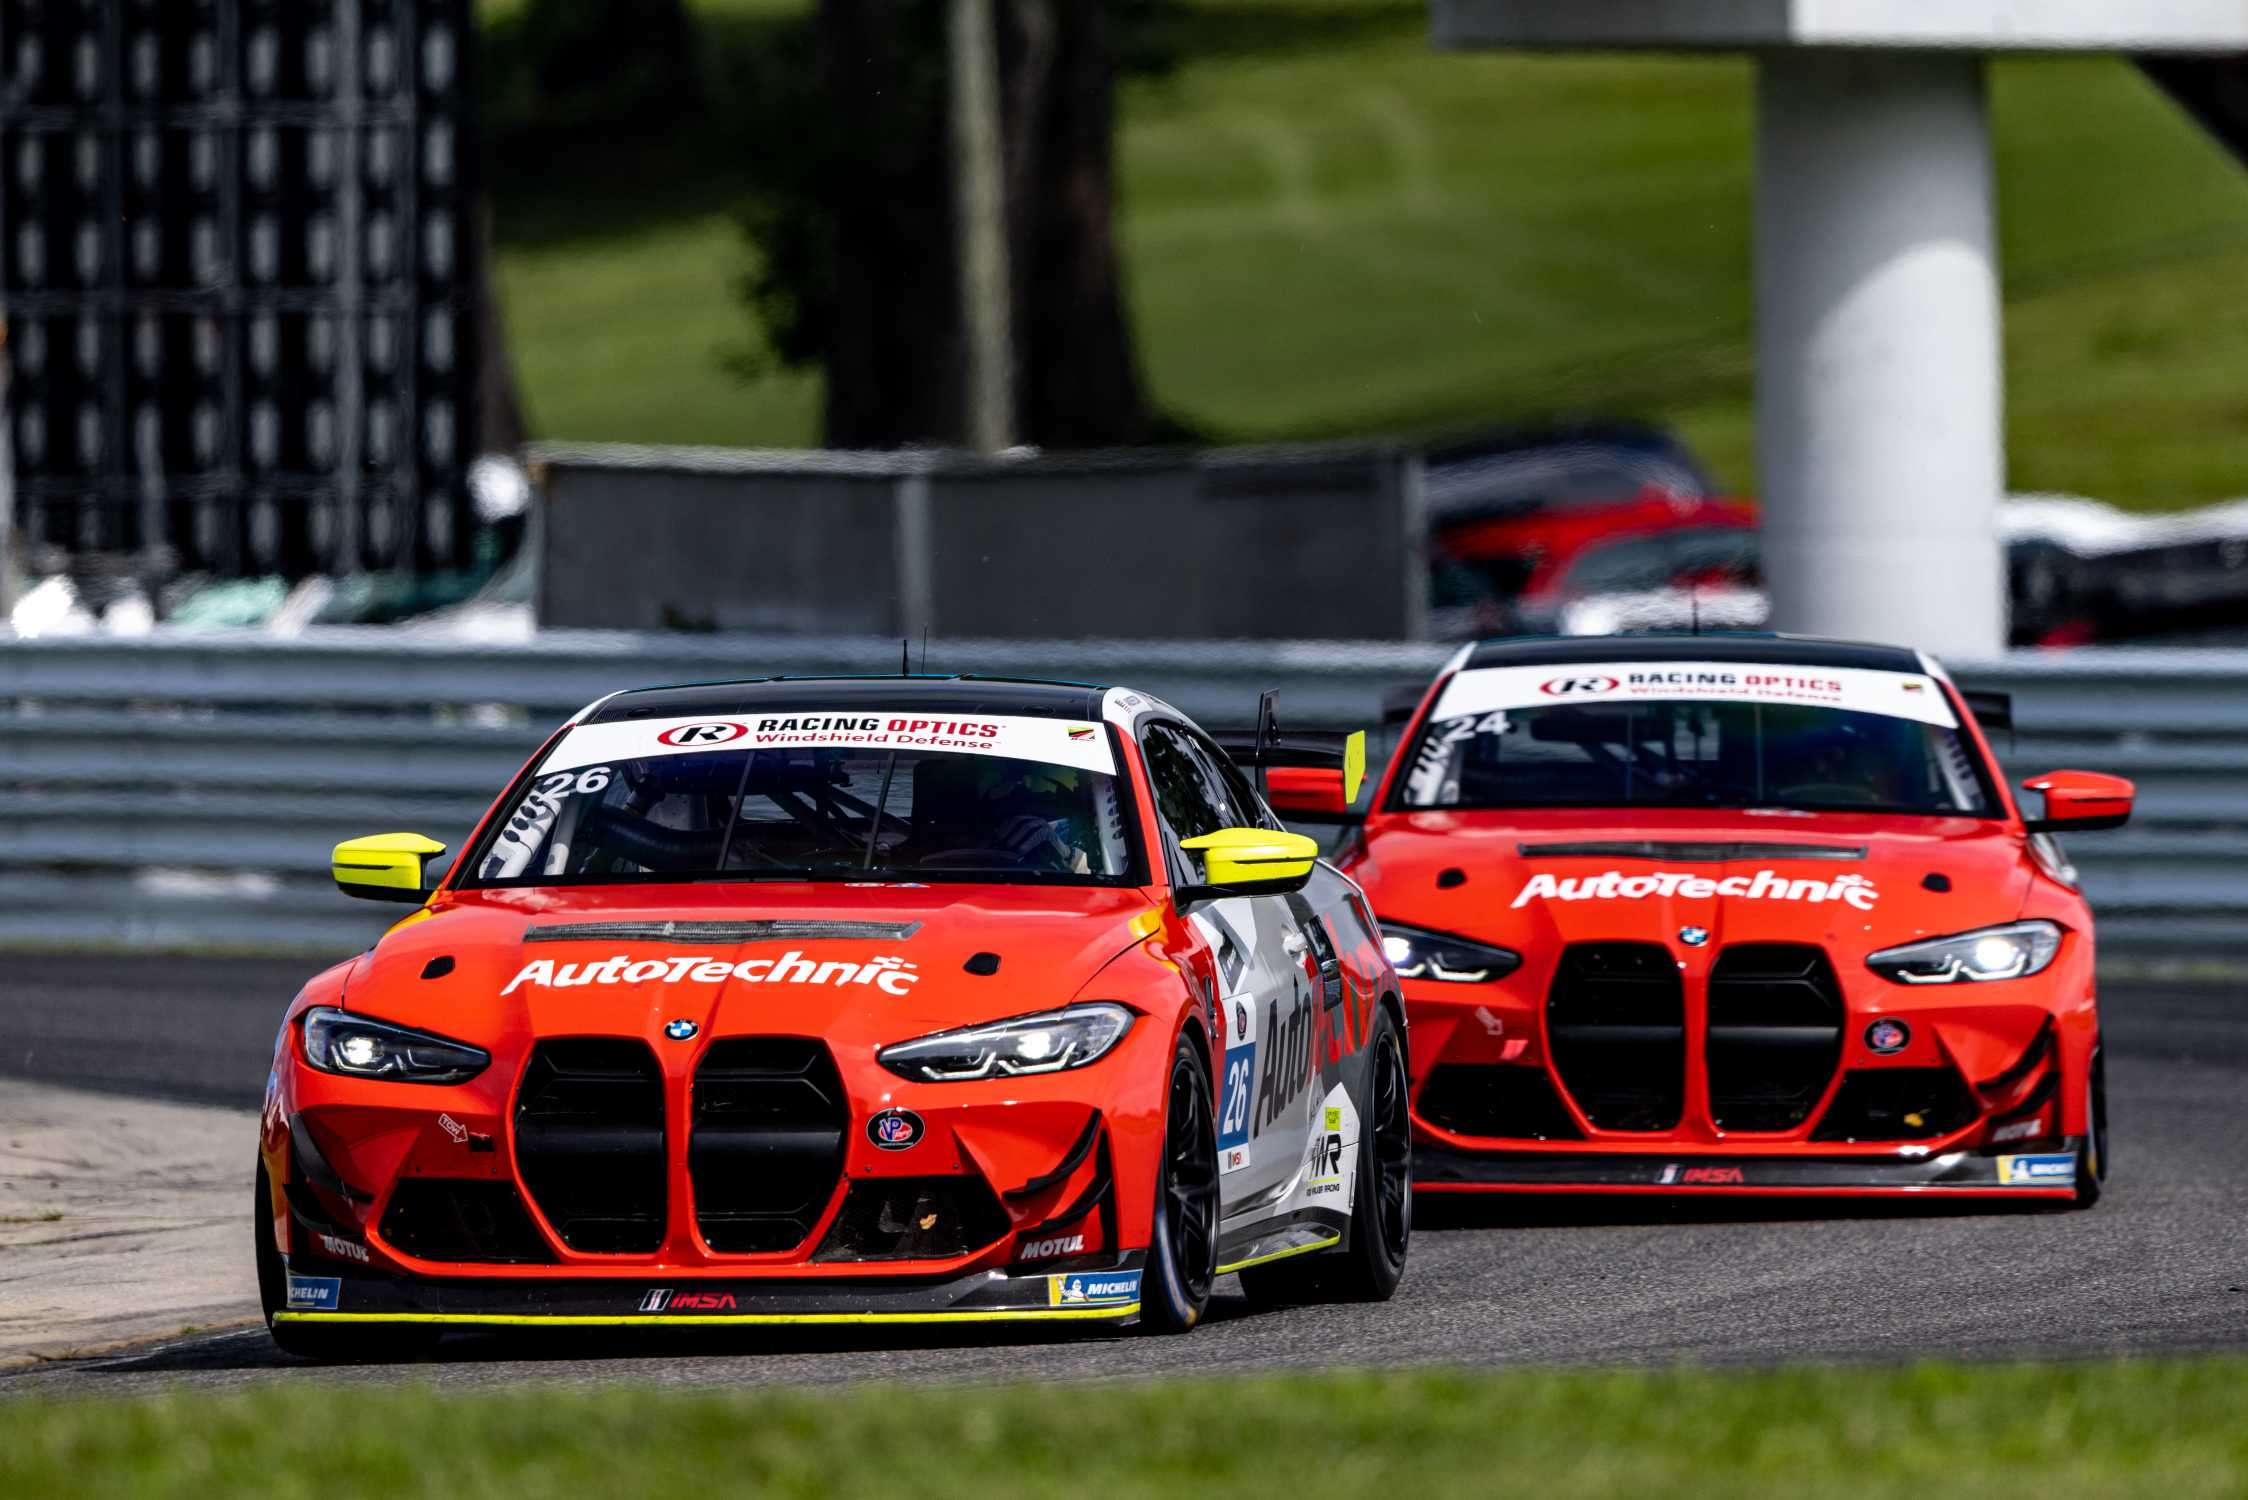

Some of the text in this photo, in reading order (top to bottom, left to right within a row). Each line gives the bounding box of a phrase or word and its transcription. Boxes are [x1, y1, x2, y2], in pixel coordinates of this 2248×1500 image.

[1629, 673, 1842, 692] RACING OPTICS
[757, 717, 998, 738] RACING OPTICS
[1441, 710, 1511, 742] 24
[755, 732, 993, 749] Windshield Defense
[537, 767, 611, 802] 26
[1510, 870, 1879, 911] AutoTechnic
[500, 951, 920, 996] AutoTechnic
[1222, 1057, 1249, 1135] 26
[319, 1234, 370, 1262] MOTUL
[1020, 1235, 1084, 1259] MOTUL
[1087, 1280, 1138, 1295] MICHELIN
[671, 1293, 737, 1309] IMSA
